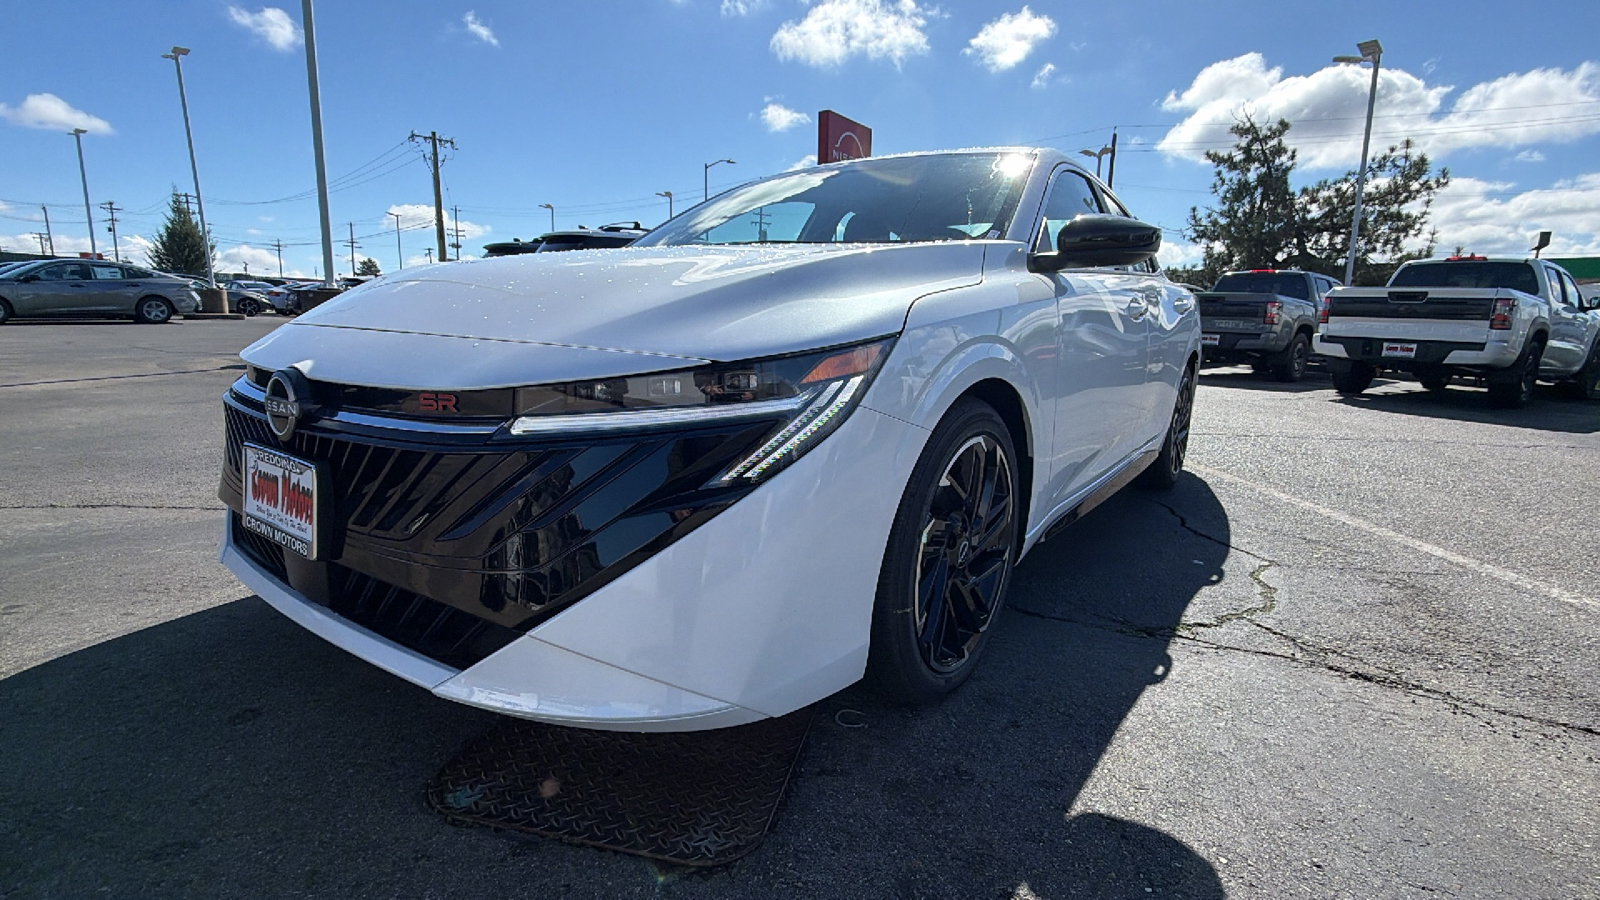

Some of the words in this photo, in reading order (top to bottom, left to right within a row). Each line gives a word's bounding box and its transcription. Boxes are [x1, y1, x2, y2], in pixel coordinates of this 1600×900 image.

[832, 149, 855, 160] NIS
[419, 393, 457, 412] SR
[246, 516, 274, 539] CROWN
[274, 529, 308, 555] MOTORS
